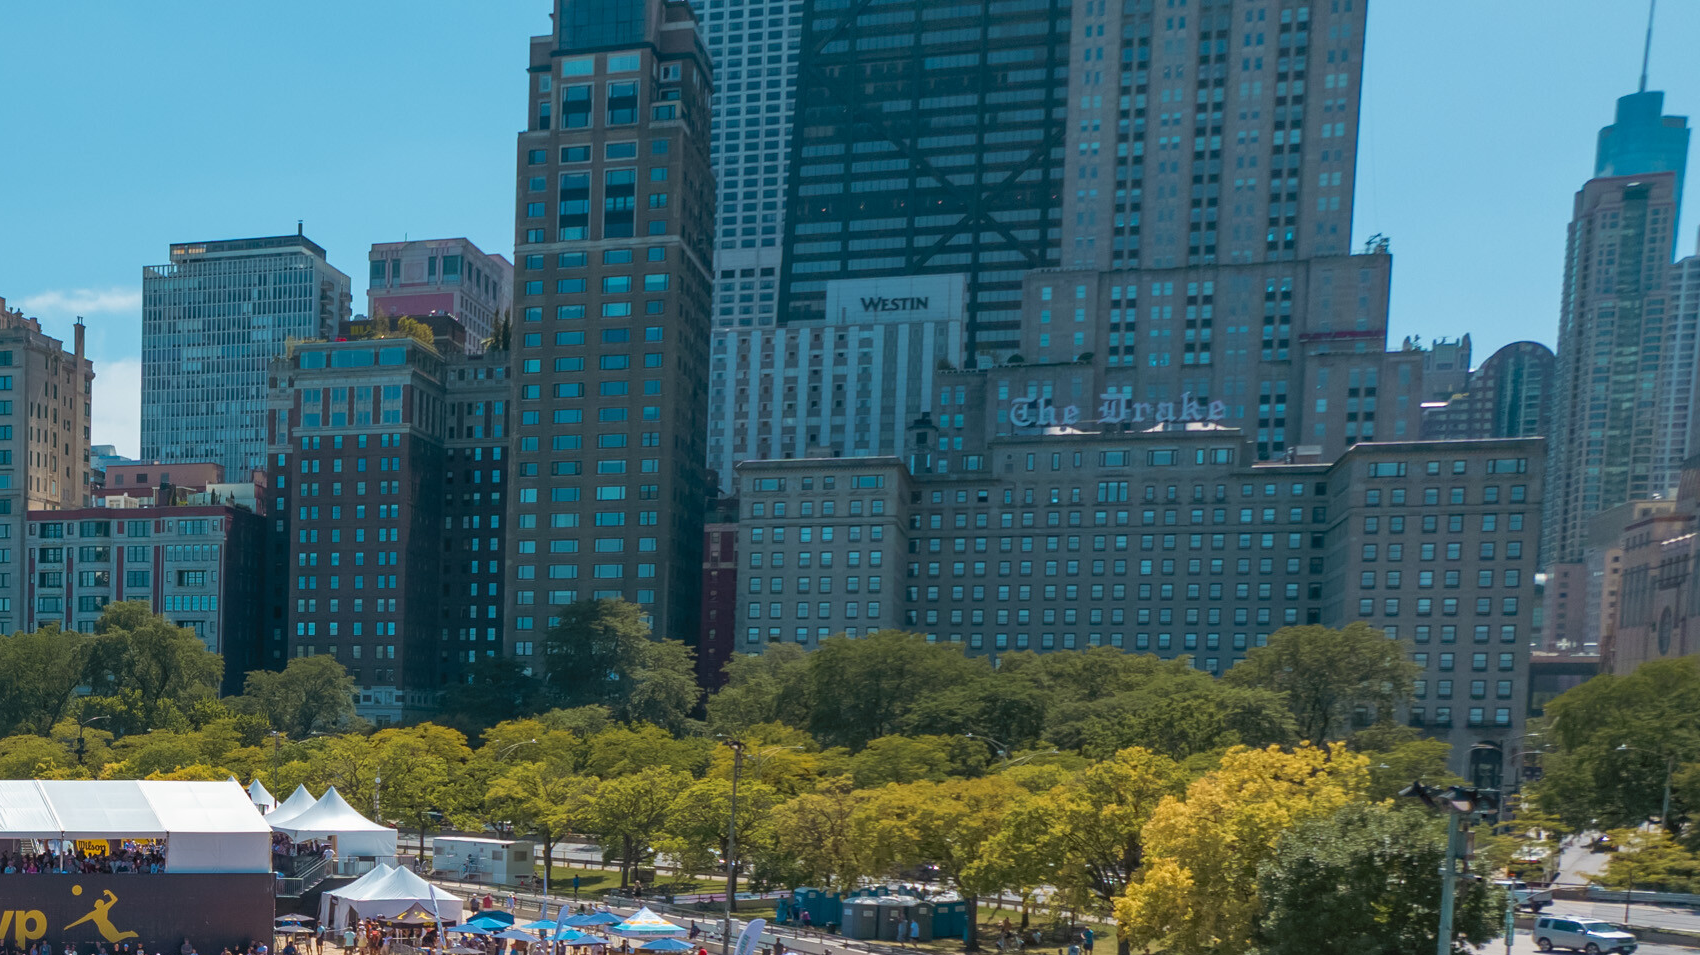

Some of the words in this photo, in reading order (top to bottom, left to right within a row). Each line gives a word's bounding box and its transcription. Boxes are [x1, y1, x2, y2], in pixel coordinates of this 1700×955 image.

[860, 296, 929, 312] WESTIN
[1009, 396, 1080, 427] The
[1098, 391, 1226, 424] Drake
[78, 840, 106, 852] Wilson
